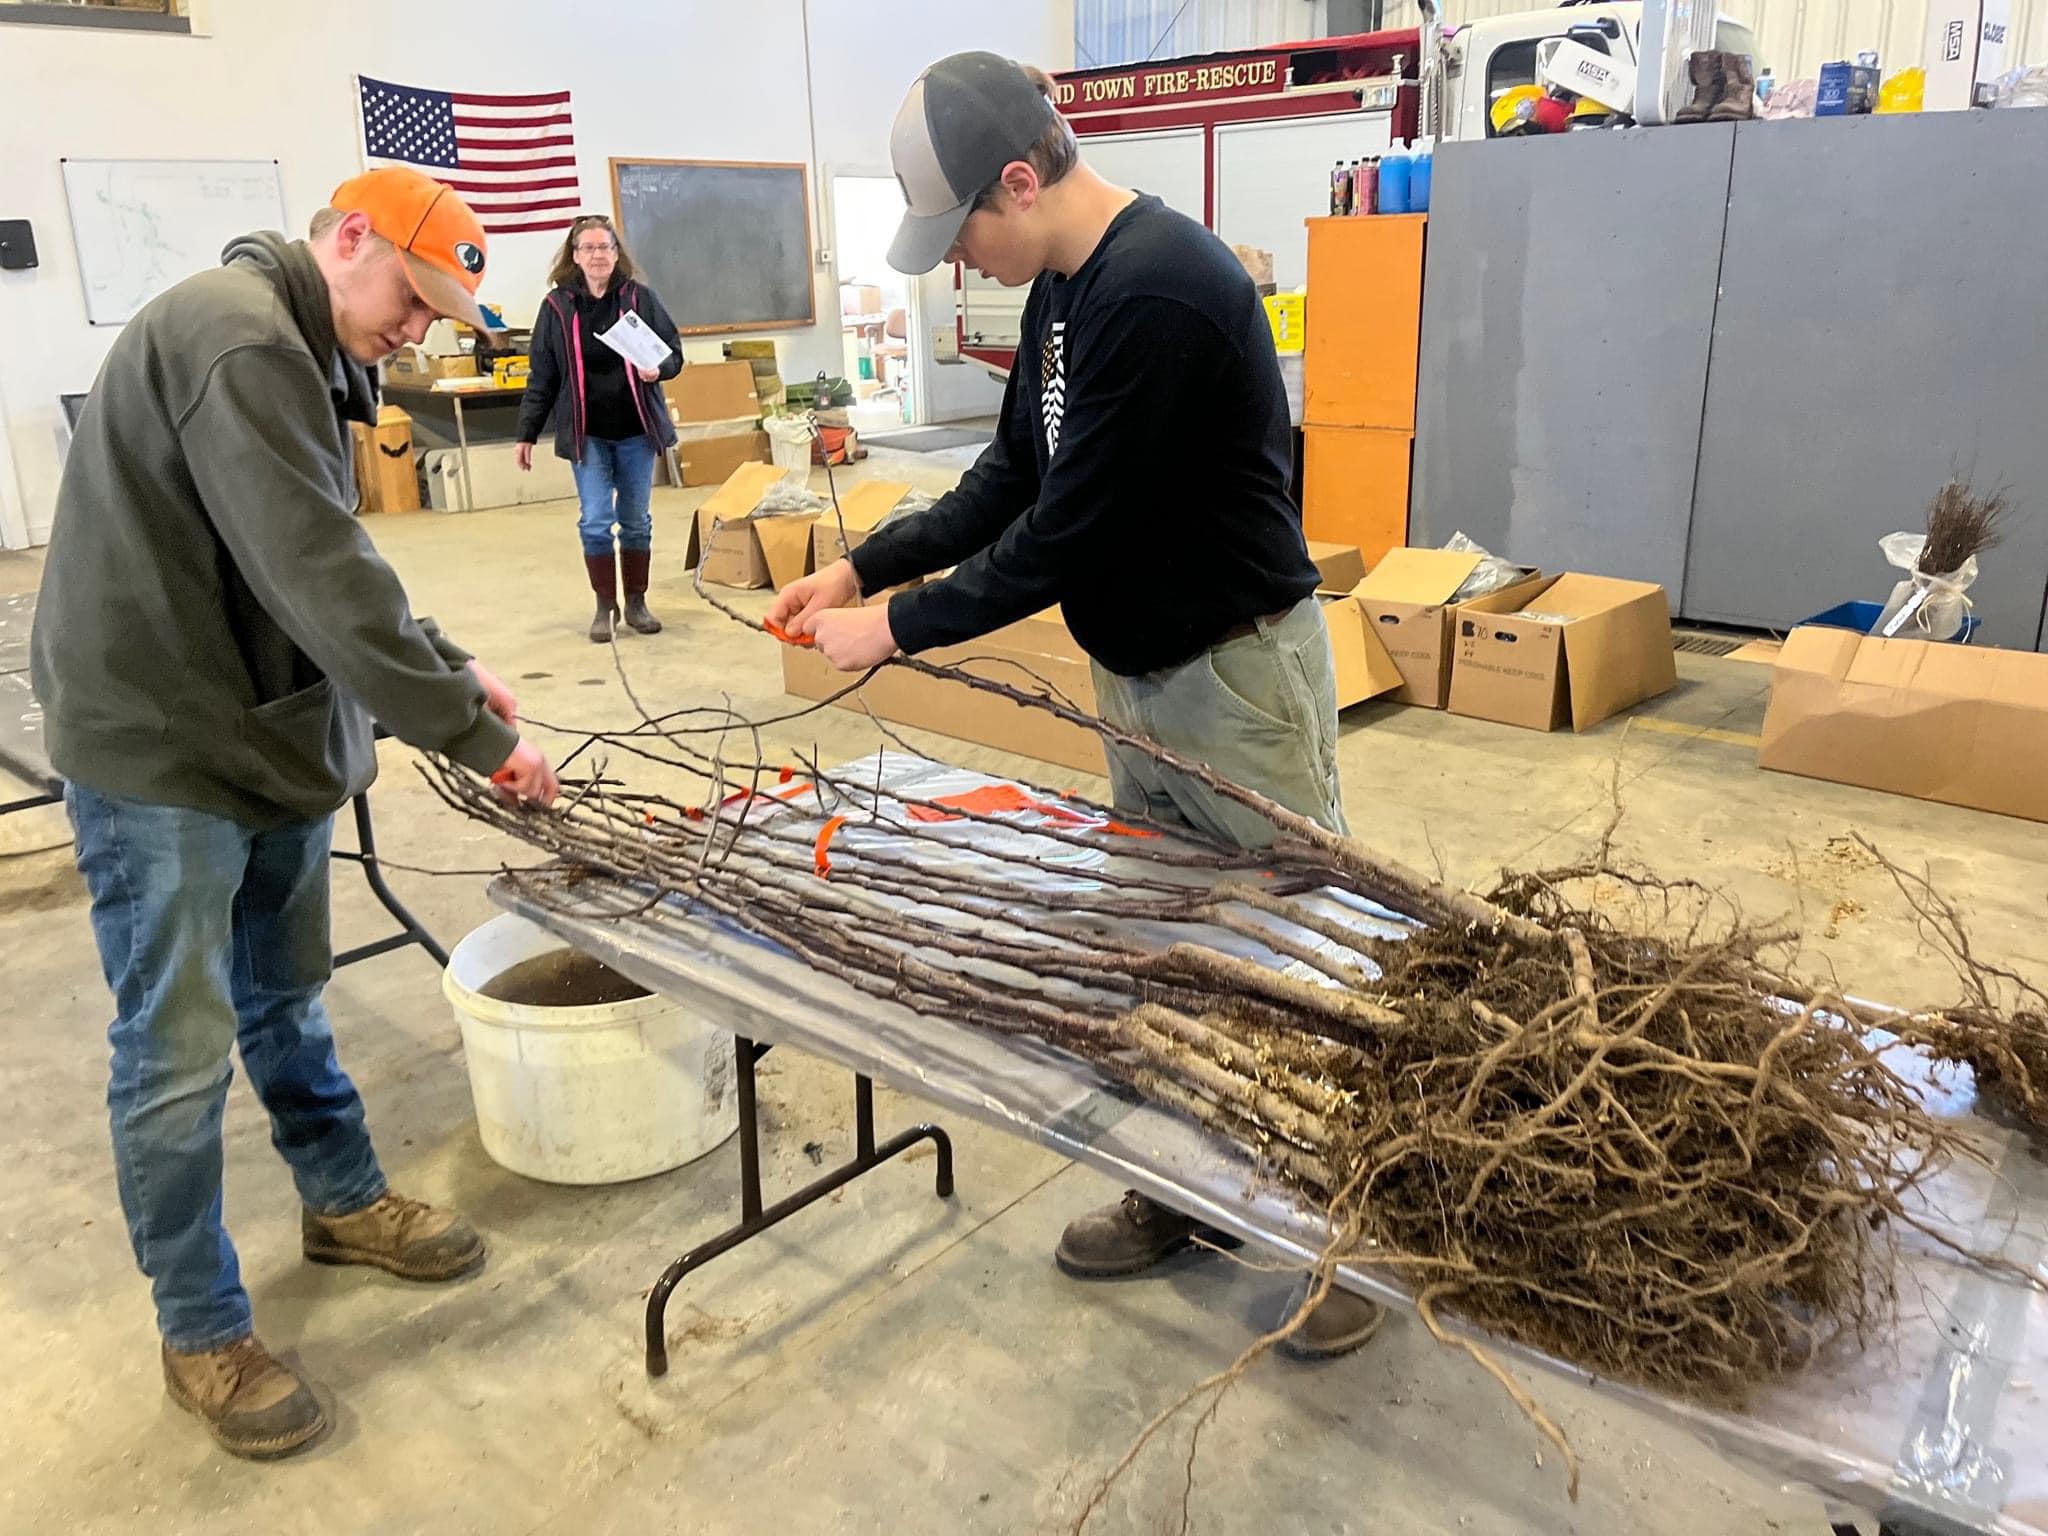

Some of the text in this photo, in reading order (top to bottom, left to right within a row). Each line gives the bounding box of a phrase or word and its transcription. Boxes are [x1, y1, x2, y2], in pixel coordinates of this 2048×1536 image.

[1946, 20, 1963, 61] MSA
[1082, 76, 1137, 102] TOWN
[1143, 60, 1276, 96] FIRE-RESCUE
[1577, 60, 1611, 82] MSA
